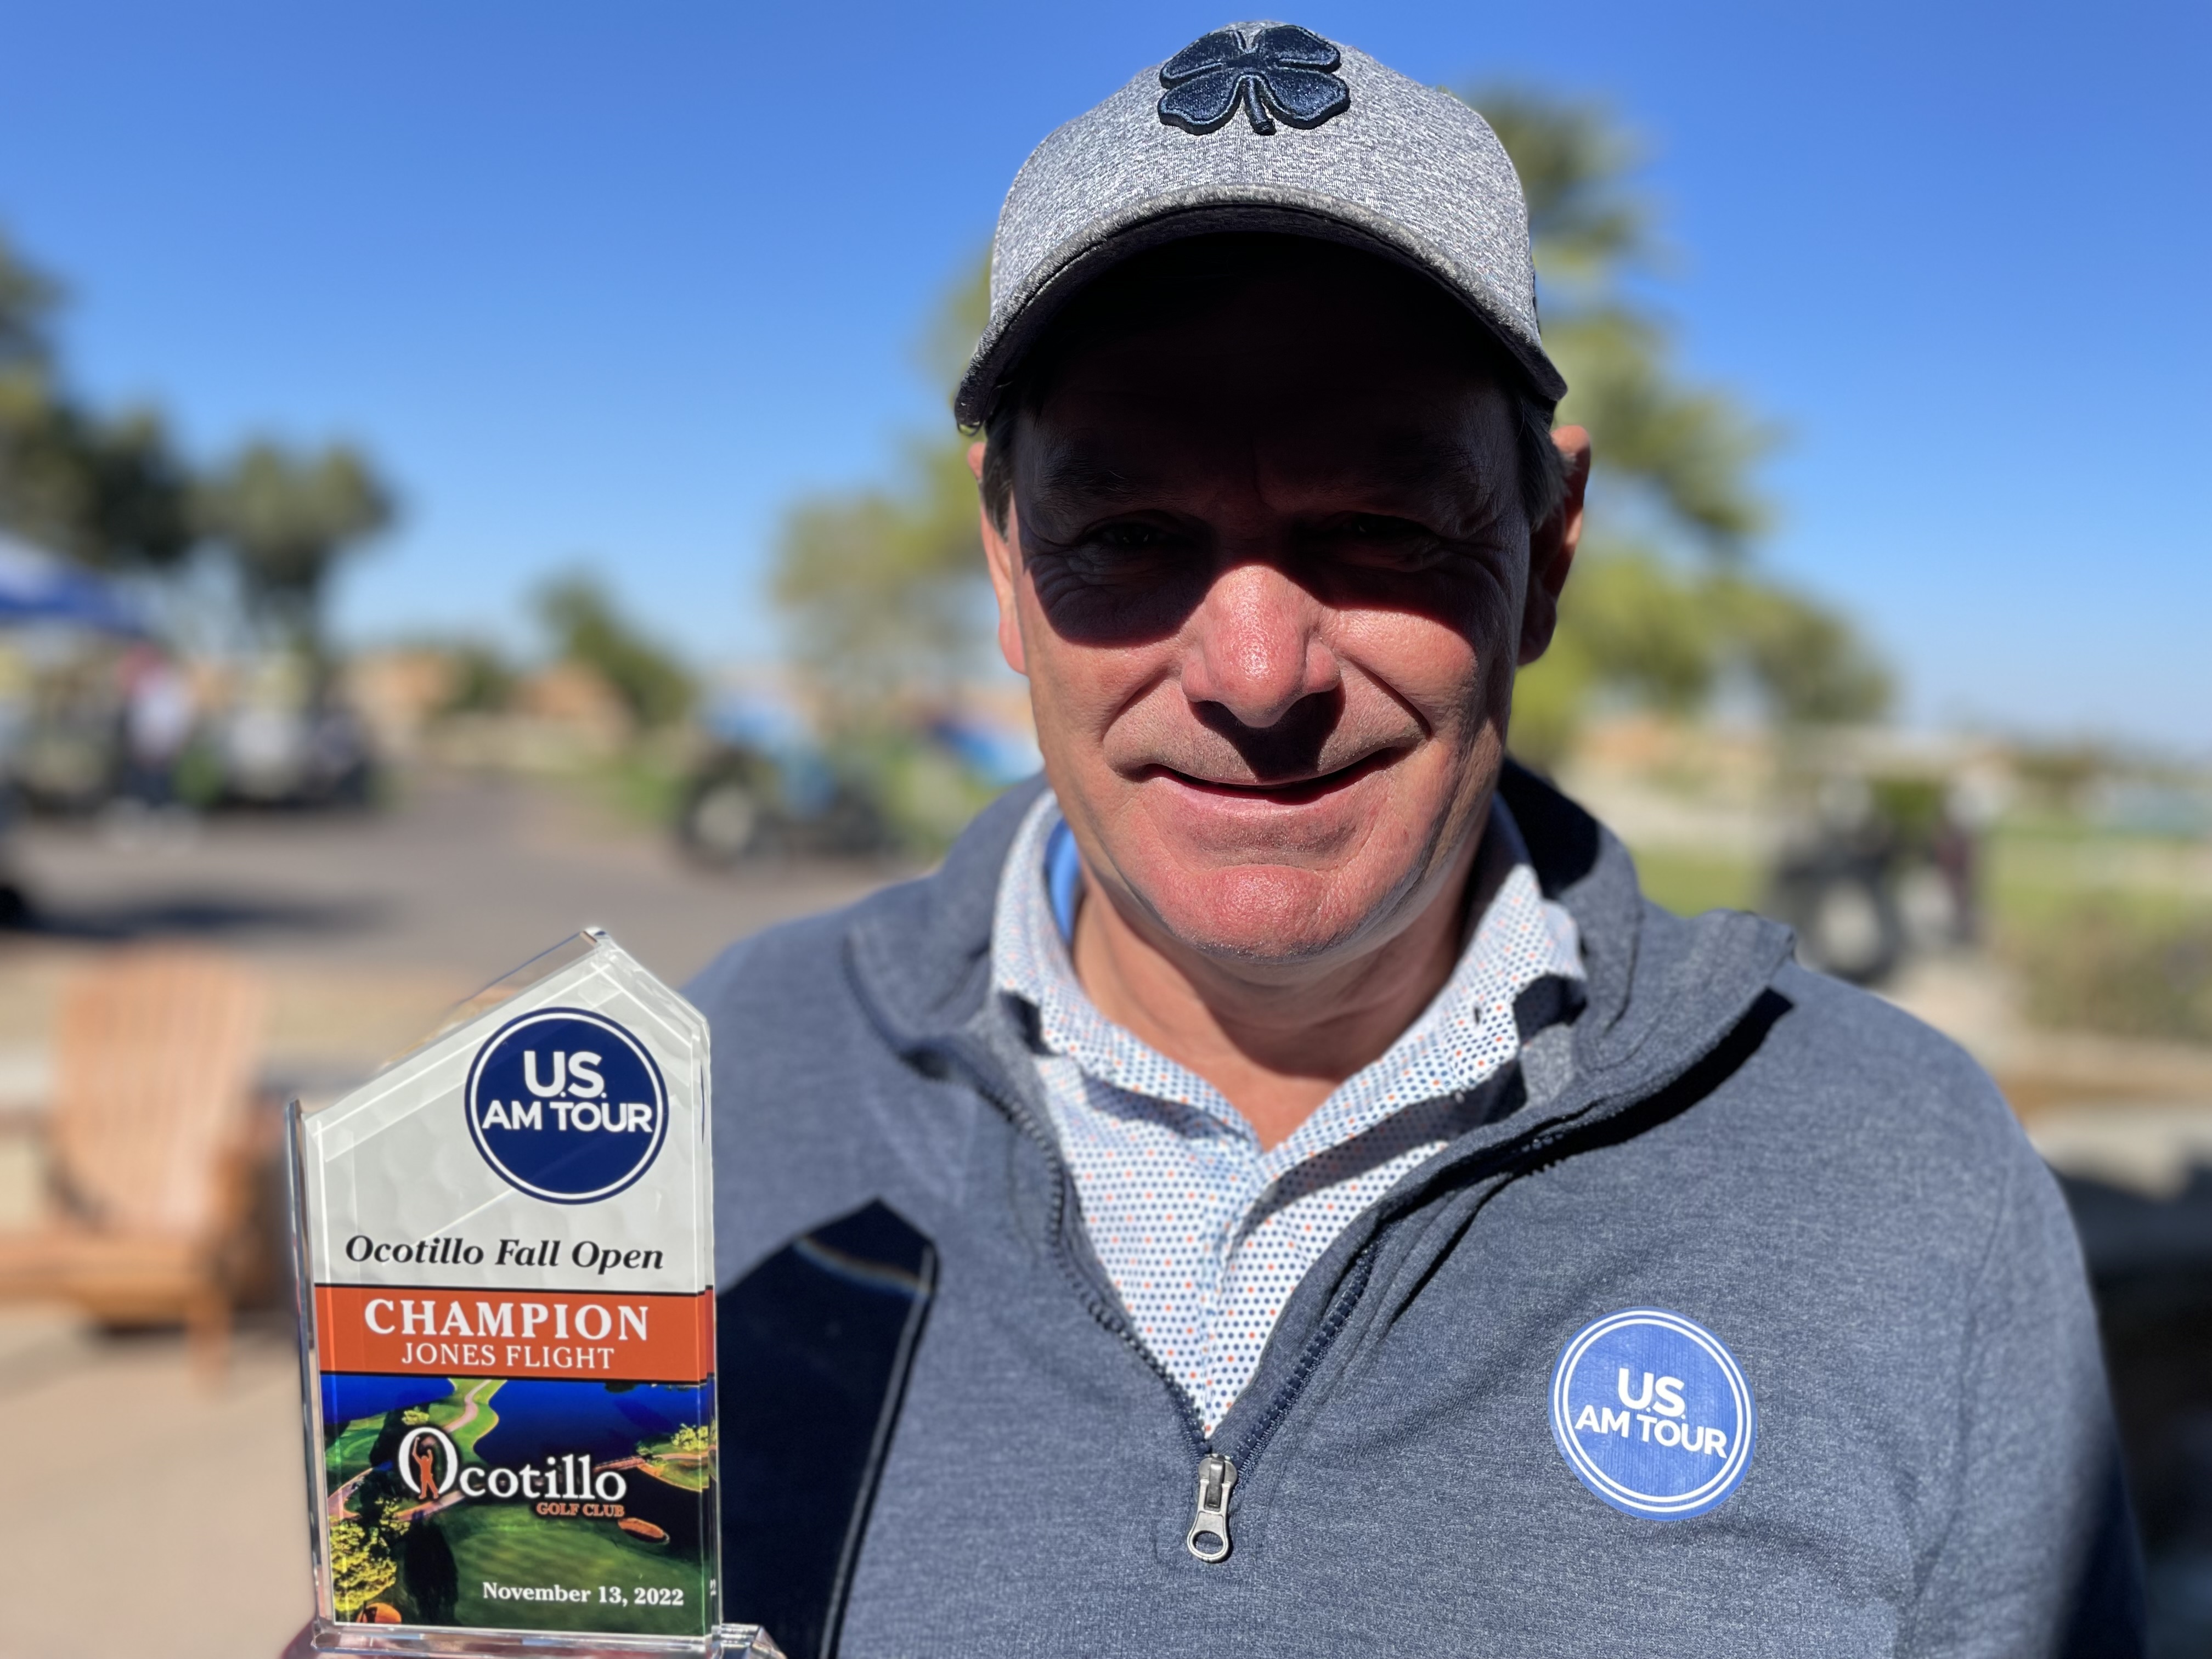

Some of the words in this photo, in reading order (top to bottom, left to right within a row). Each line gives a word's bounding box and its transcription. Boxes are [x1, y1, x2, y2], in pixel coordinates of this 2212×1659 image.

[523, 1050, 607, 1099] U.S.
[482, 1100, 542, 1131] AM
[549, 1102, 653, 1132] TOUR
[346, 1234, 484, 1266] Ocotillo
[495, 1239, 561, 1268] Fall
[571, 1240, 664, 1275] Open
[364, 1297, 649, 1341] CHAMPION
[402, 1342, 496, 1367] JONES
[506, 1345, 614, 1369] FLIGHT
[1617, 1367, 1686, 1420] U.S.
[1575, 1404, 1629, 1438] AM
[1637, 1414, 1728, 1459] TOUR
[398, 1425, 627, 1502] Ocotillo
[536, 1502, 579, 1516] GOLF
[583, 1503, 625, 1517] CLUB
[482, 1581, 591, 1604] November
[598, 1585, 628, 1607] 13,
[634, 1587, 684, 1606] 2022
